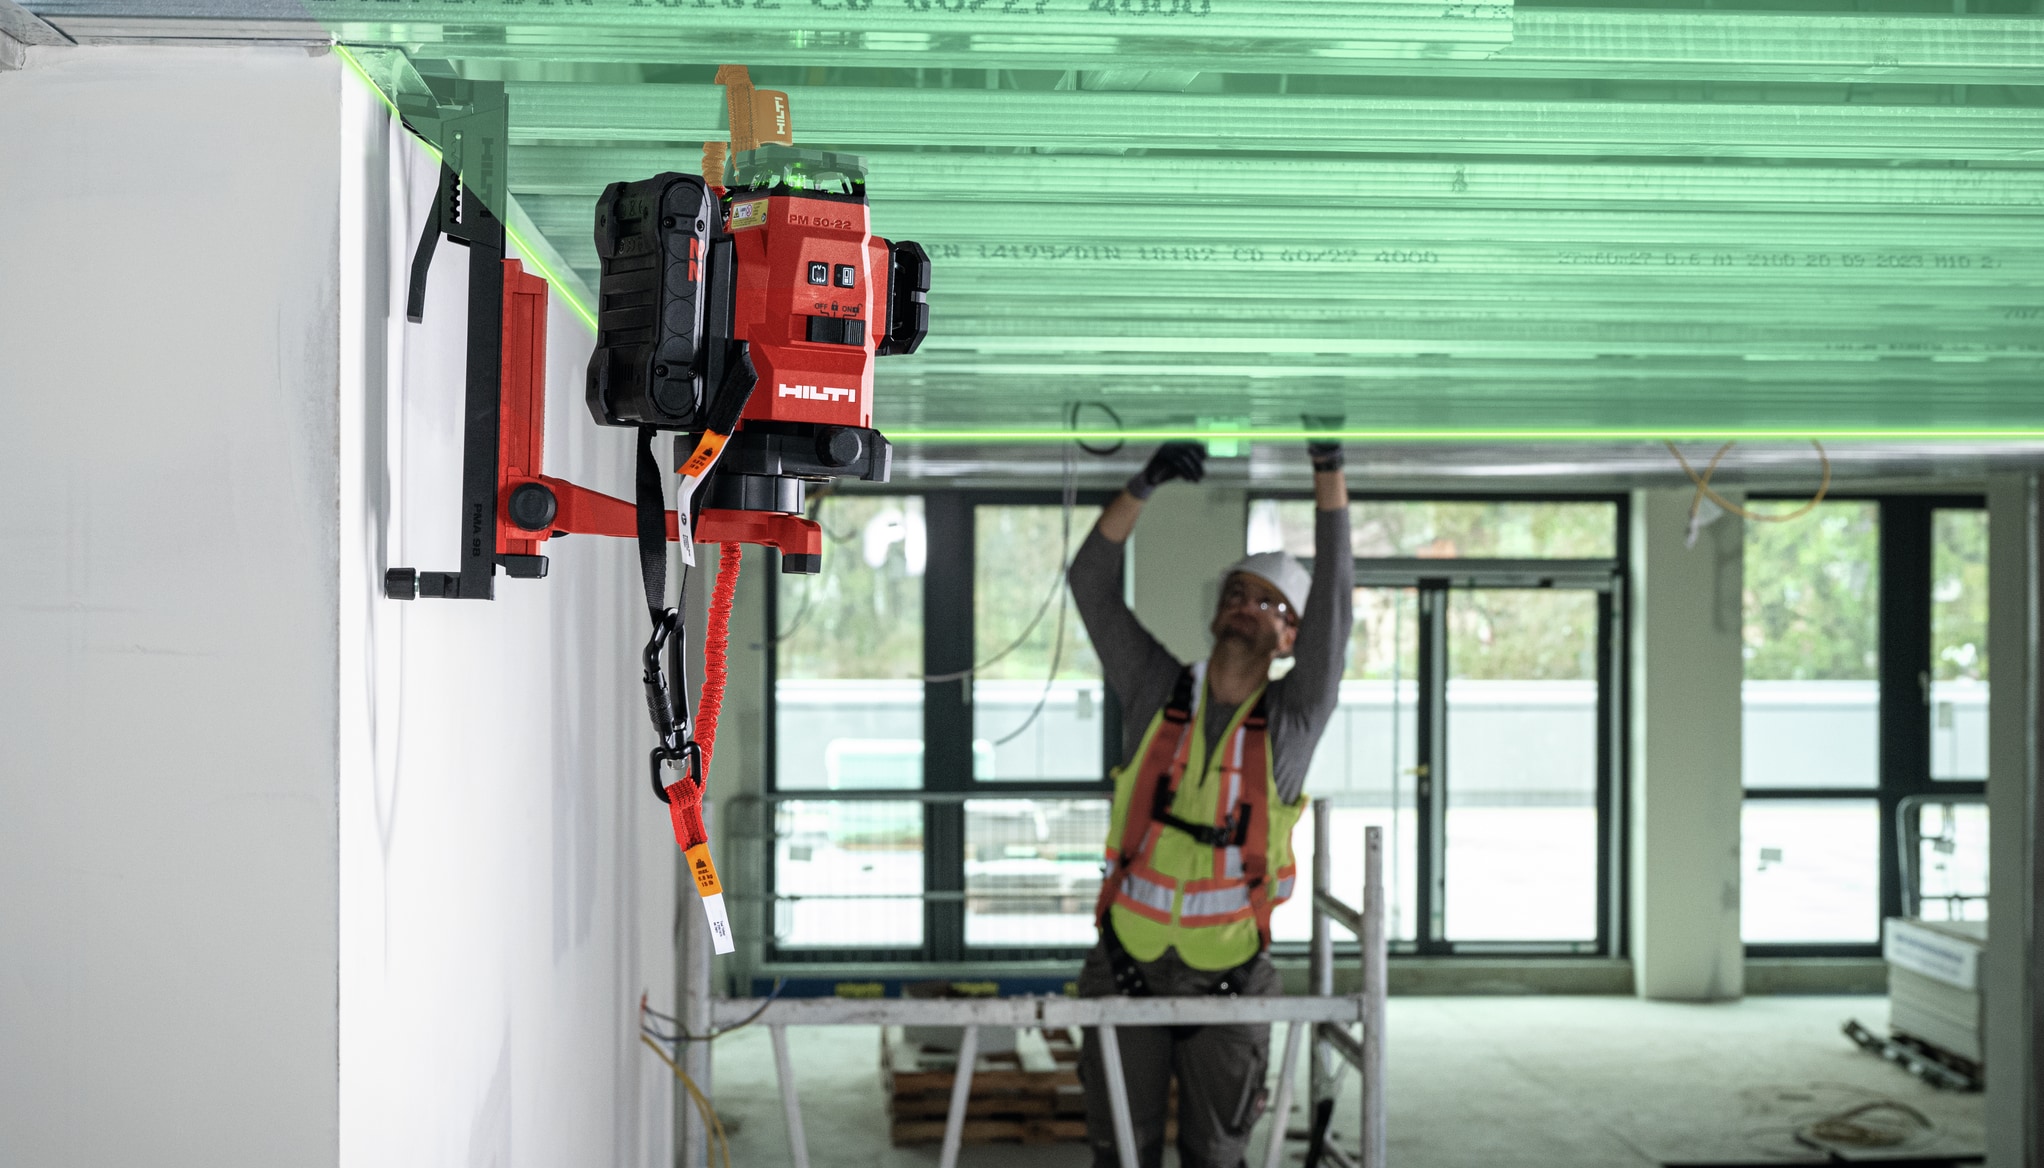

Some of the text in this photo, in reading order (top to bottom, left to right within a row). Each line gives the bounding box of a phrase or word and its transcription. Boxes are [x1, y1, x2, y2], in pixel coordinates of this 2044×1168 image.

[774, 96, 786, 135] HILTI
[480, 137, 494, 218] HILTI
[789, 214, 852, 230] PM 50-22
[1374, 248, 1439, 264] 4000
[1876, 254, 1923, 269] 2023
[778, 383, 856, 403] HILTI
[472, 503, 482, 534] PMA
